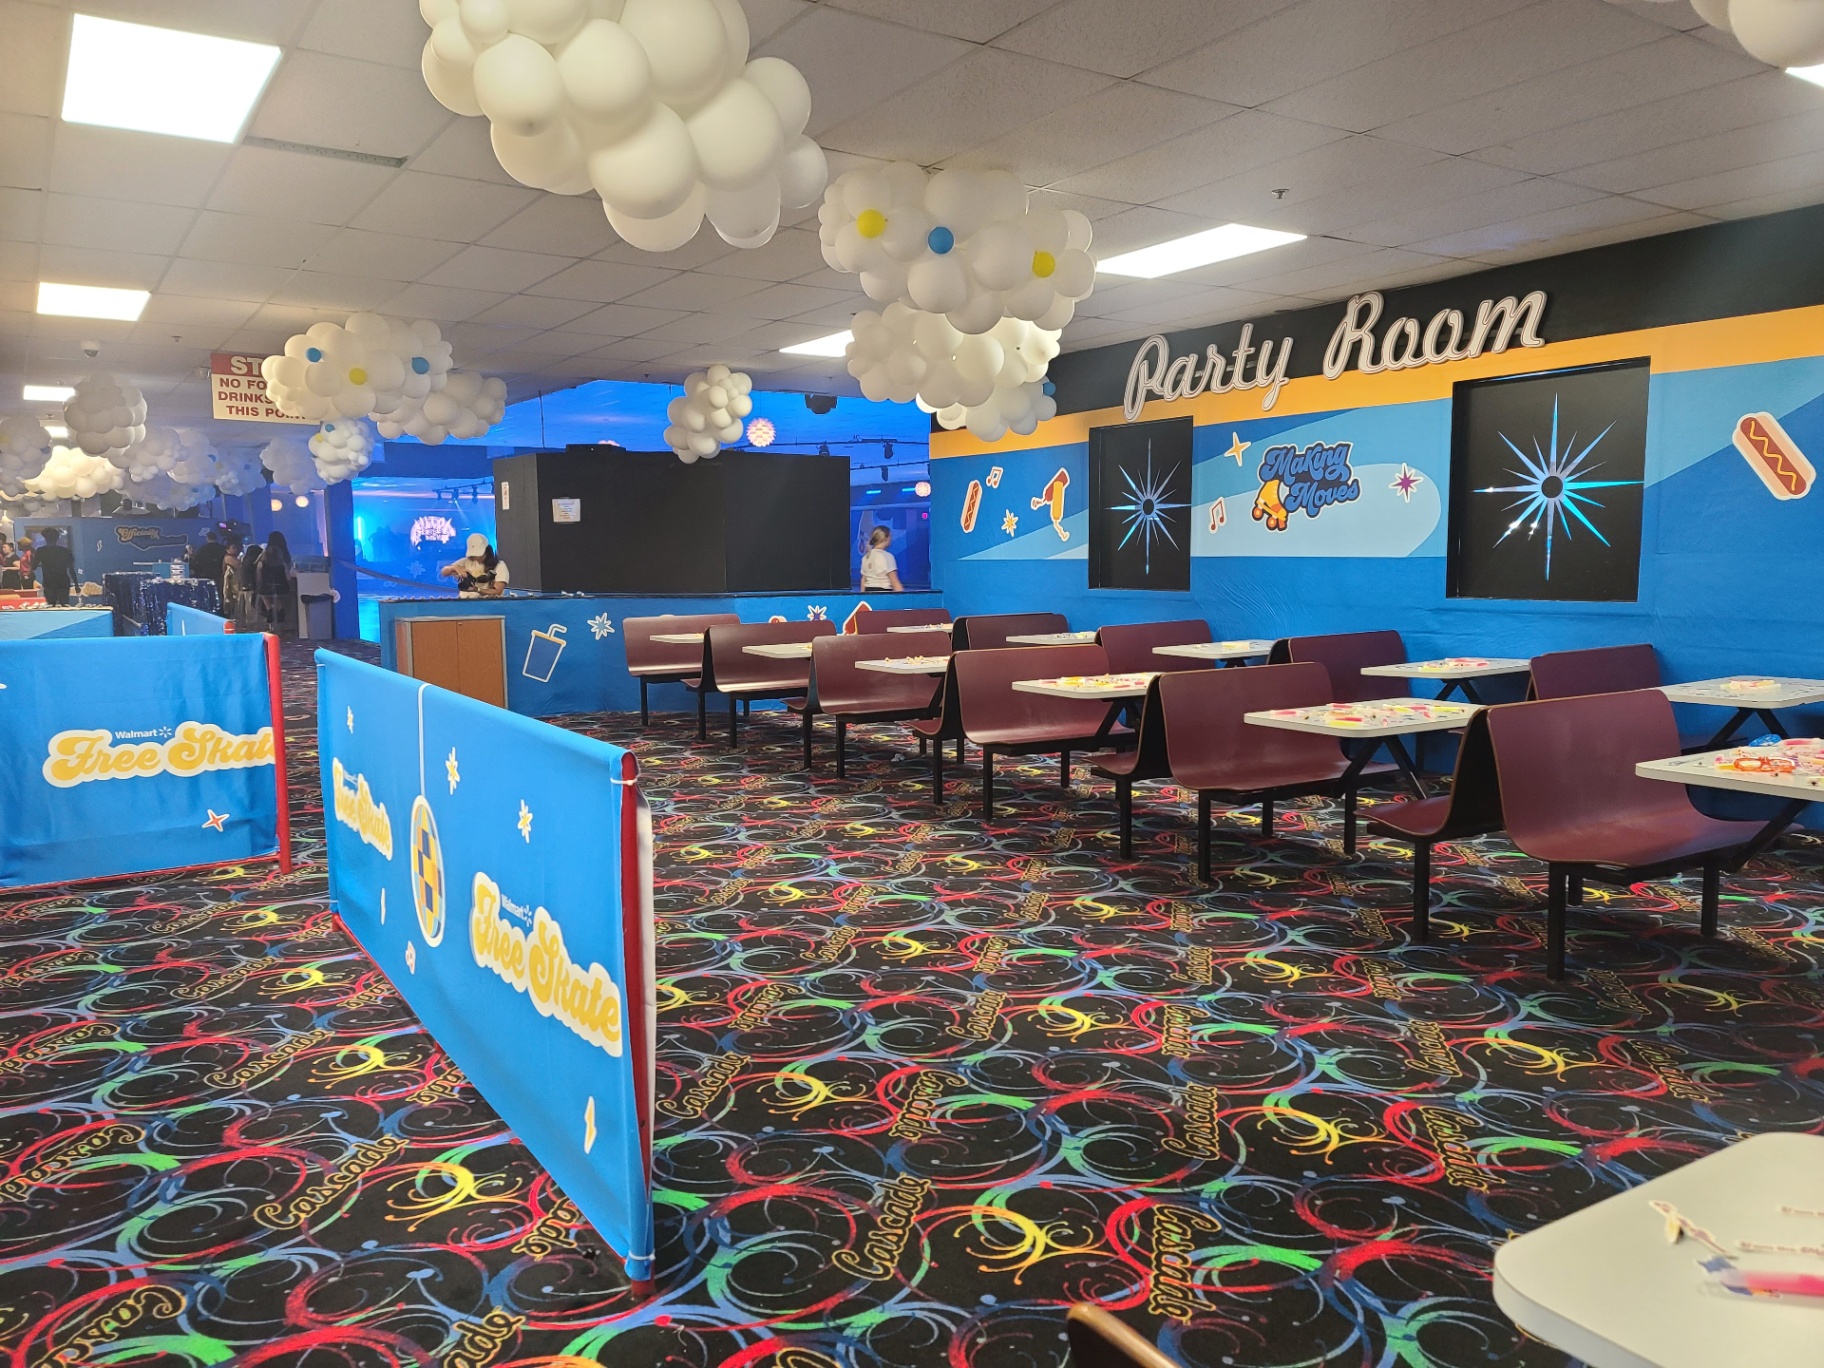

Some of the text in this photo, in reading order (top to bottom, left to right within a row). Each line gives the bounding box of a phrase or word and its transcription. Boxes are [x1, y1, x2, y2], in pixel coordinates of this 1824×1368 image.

[219, 377, 268, 390] NO FO
[230, 355, 263, 375] ST
[1123, 291, 1548, 422] Party Room
[226, 405, 259, 417] THIS
[1284, 481, 1359, 517] Moves
[50, 726, 276, 782] Free Skat
[115, 730, 158, 740] Walmart
[474, 883, 621, 1043] Free Skate
[0, 1023, 121, 1074] Cascad
[945, 988, 1008, 1043] Cascade
[206, 1029, 333, 1091] Cascade
[655, 1051, 752, 1120] Cascade
[886, 1069, 969, 1142] Cascade
[1161, 1081, 1220, 1161] Cascade
[0, 1123, 146, 1203] Cascad
[253, 1133, 405, 1231] Cascade
[1420, 1104, 1506, 1193] Cascade
[832, 1172, 932, 1282] Cascade
[1148, 1203, 1222, 1326] Cascade
[30, 1284, 188, 1368] Casc
